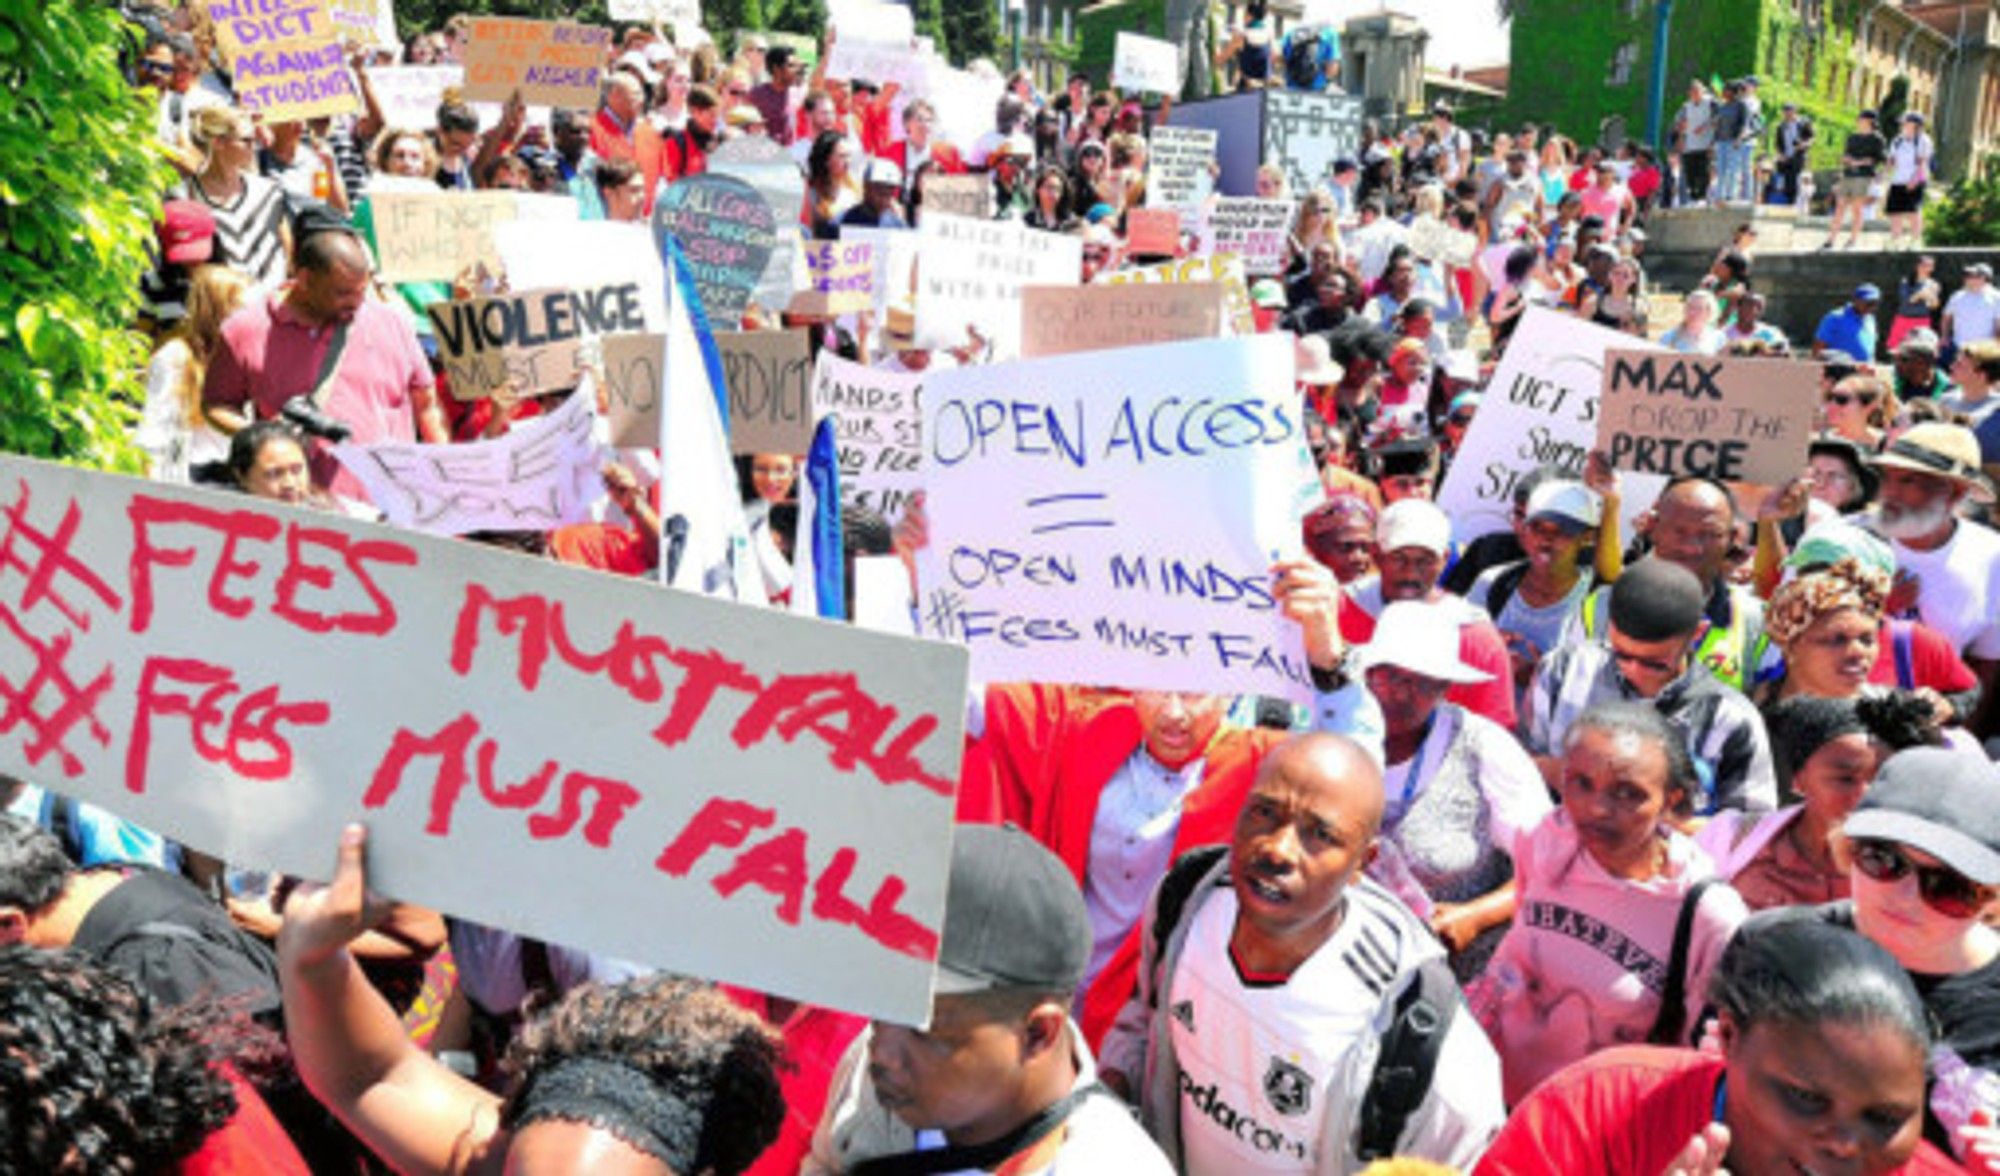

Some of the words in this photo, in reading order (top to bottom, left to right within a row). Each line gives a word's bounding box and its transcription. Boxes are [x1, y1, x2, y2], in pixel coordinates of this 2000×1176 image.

[232, 6, 318, 45] DICT
[427, 283, 645, 357] VIOLENCE
[604, 356, 657, 414] NO
[724, 348, 809, 427] RDICT
[1509, 373, 1574, 415] UCT
[1611, 356, 1724, 400] MAX
[933, 395, 1086, 467] OPEN
[1104, 396, 1294, 463] ACCESS
[1631, 404, 1720, 432] DROP
[1731, 407, 1789, 440] THE
[1610, 431, 1749, 481] PRICE
[948, 545, 1078, 590] OPEN
[1110, 553, 1278, 611] MINDS
[1093, 616, 1194, 658] MUST
[361, 709, 642, 849] MUST
[654, 795, 939, 962] FALL
